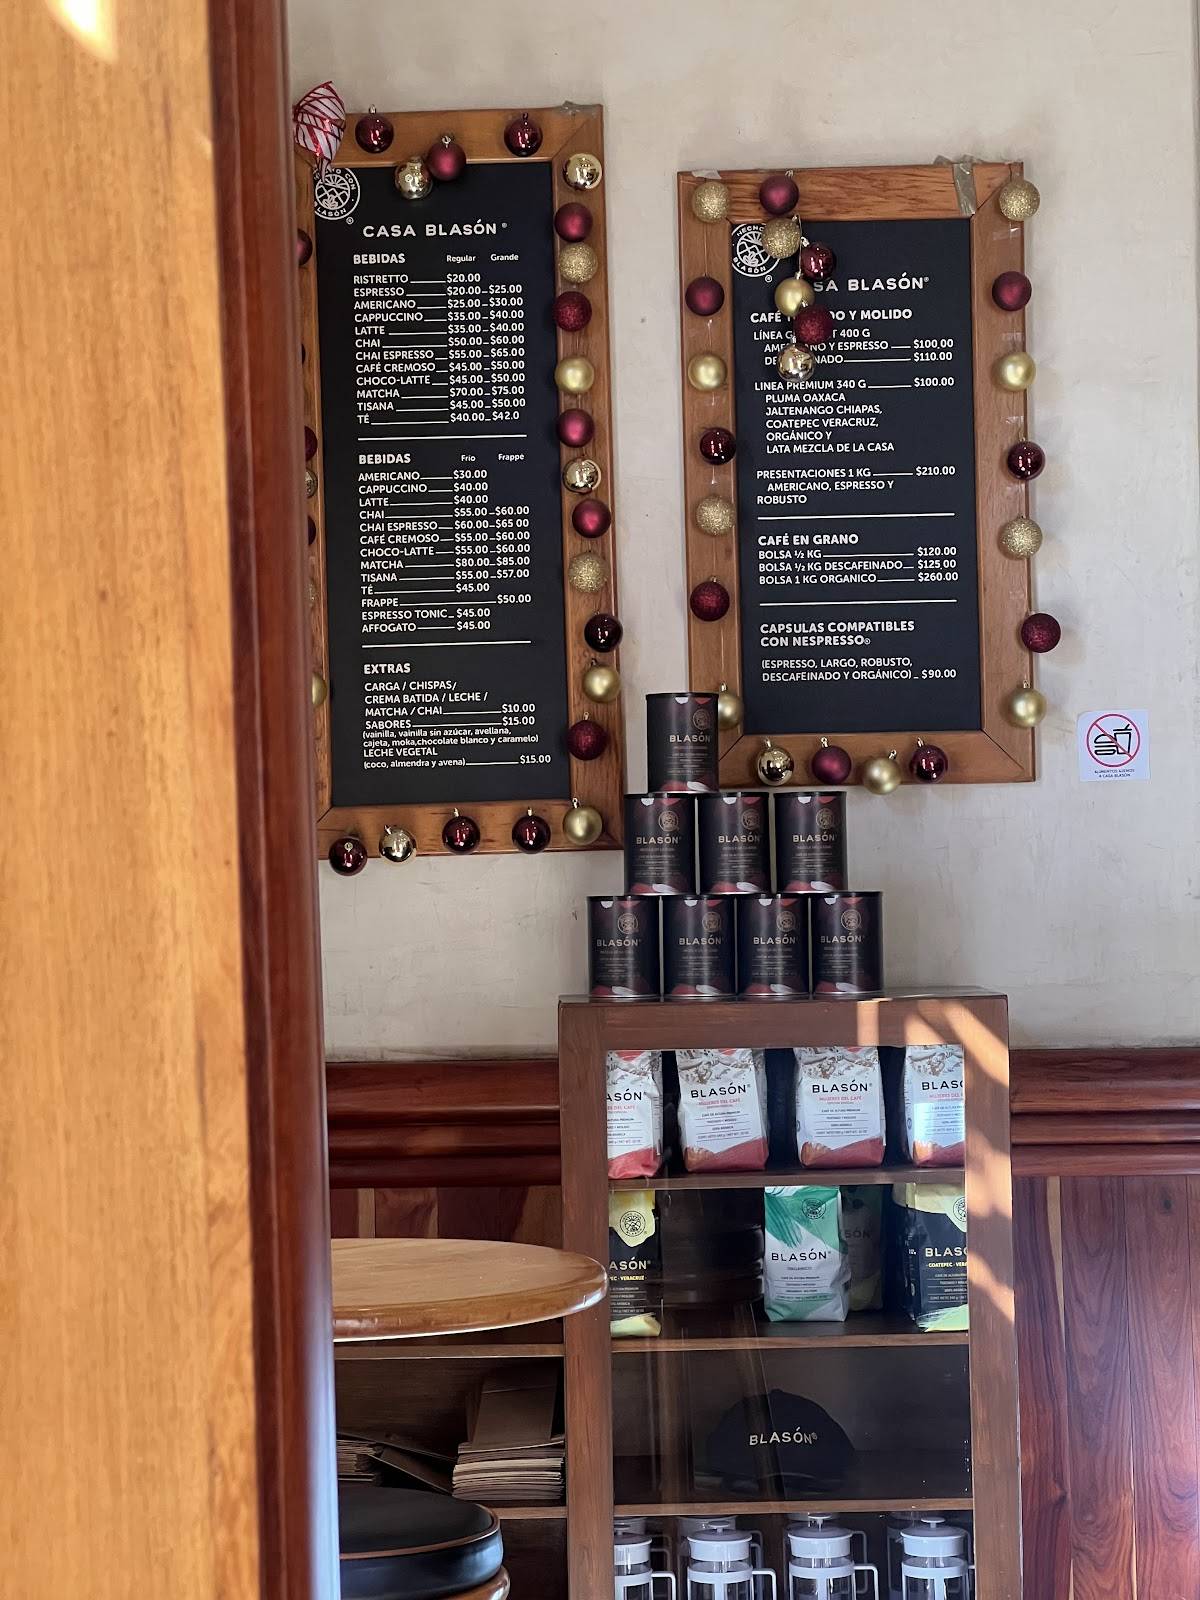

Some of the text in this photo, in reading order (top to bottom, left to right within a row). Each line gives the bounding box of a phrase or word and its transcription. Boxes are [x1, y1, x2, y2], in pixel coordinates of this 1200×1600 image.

[363, 225, 416, 237] CASA
[354, 253, 405, 264] BEBIDAS
[447, 255, 476, 263] Regular
[354, 274, 480, 284] RISTRETTO $20.00
[354, 286, 481, 297] ESPRESSO $20.00
[354, 299, 480, 309] AMERICANO $25.00
[355, 312, 480, 322] CAPPUCCINO $35.00
[750, 310, 781, 323] CAFÉ
[861, 309, 912, 320] MOLIDO
[355, 324, 481, 335] LATTE $35.00
[754, 330, 782, 340] LÍNEA
[840, 329, 859, 337] 400
[356, 337, 482, 348] CHAI $50.00
[838, 341, 888, 350] ESPRESSO
[914, 339, 953, 349] $100.00
[356, 350, 482, 360] CHAI ESPRESSO $55.00
[914, 352, 952, 362] $110.00
[356, 362, 482, 373] CAFÉ CREMOSO $45.00
[356, 375, 483, 386] CHOCO-LATTE $45.00
[787, 379, 834, 390] PREMIUM
[837, 380, 855, 388] 340
[914, 377, 954, 387] $100.00
[357, 388, 483, 398] MATCHA $70.00
[766, 393, 845, 403] PLUMA OAXACA
[357, 400, 483, 411] TISANA $45.00
[766, 404, 882, 416] JALTENANGO CHIAPAS,
[357, 413, 484, 424] TÉ $40.00
[766, 418, 878, 428] COATEPEC VERACRUZ,
[766, 430, 823, 441] ORGÁNICO
[767, 442, 894, 454] LATA MEZCLA CASA
[359, 454, 410, 464] BEBIDAS
[358, 472, 420, 481] AMERICANO
[757, 466, 955, 479] PRESENTACIONES $210.00
[359, 484, 427, 494] CAPPUCCINO
[768, 481, 885, 491] AMERICANO, ESPRESSO
[360, 498, 389, 506] LATTE
[757, 495, 807, 504] ROBUSTO
[360, 510, 384, 519] CHAI
[360, 521, 437, 532] CHAI ESPRESSO
[360, 534, 439, 544] CAFÉ CREMOSO
[758, 533, 858, 546] CAFÉ GRANO
[360, 546, 434, 557] CHOCO-LATTE
[759, 546, 956, 559] BOLSA $120.00
[361, 560, 403, 569] MATCHA
[759, 559, 956, 572] BOLSA DESCAFEINADO $125.00
[361, 573, 397, 582] TISANA
[760, 572, 958, 584] BOLSA ORGANICO $260.00
[361, 584, 373, 594] TÉ
[362, 598, 398, 607] FRAPPE
[362, 609, 447, 620] ESPRESSO TONIC
[362, 623, 416, 632] AFFOGATO
[760, 621, 914, 633] CAPSULAS COMPATIBLES
[761, 637, 788, 646] CON
[762, 657, 912, 668] (ESPRESSO, LARGO, ROBUSTO,
[364, 663, 410, 674] EXTRAS
[763, 669, 956, 681] DESCAFEINADO ORGÁNICO) $90.00
[365, 682, 400, 691] CARGA
[365, 692, 481, 704] CREMA BATIDA LECHE
[366, 704, 535, 716] MATCHA CHAI $10.00
[366, 716, 535, 729] SABORES $15.00
[363, 730, 396, 739] (vainilla,
[444, 728, 473, 736] azúcar,
[474, 727, 512, 736] avellana,
[363, 740, 390, 748] cajeta,
[498, 734, 539, 744] caramelo)
[364, 747, 438, 757] LECHE VEGETAL
[438, 758, 465, 766] avena)
[520, 755, 551, 764] $15.00
